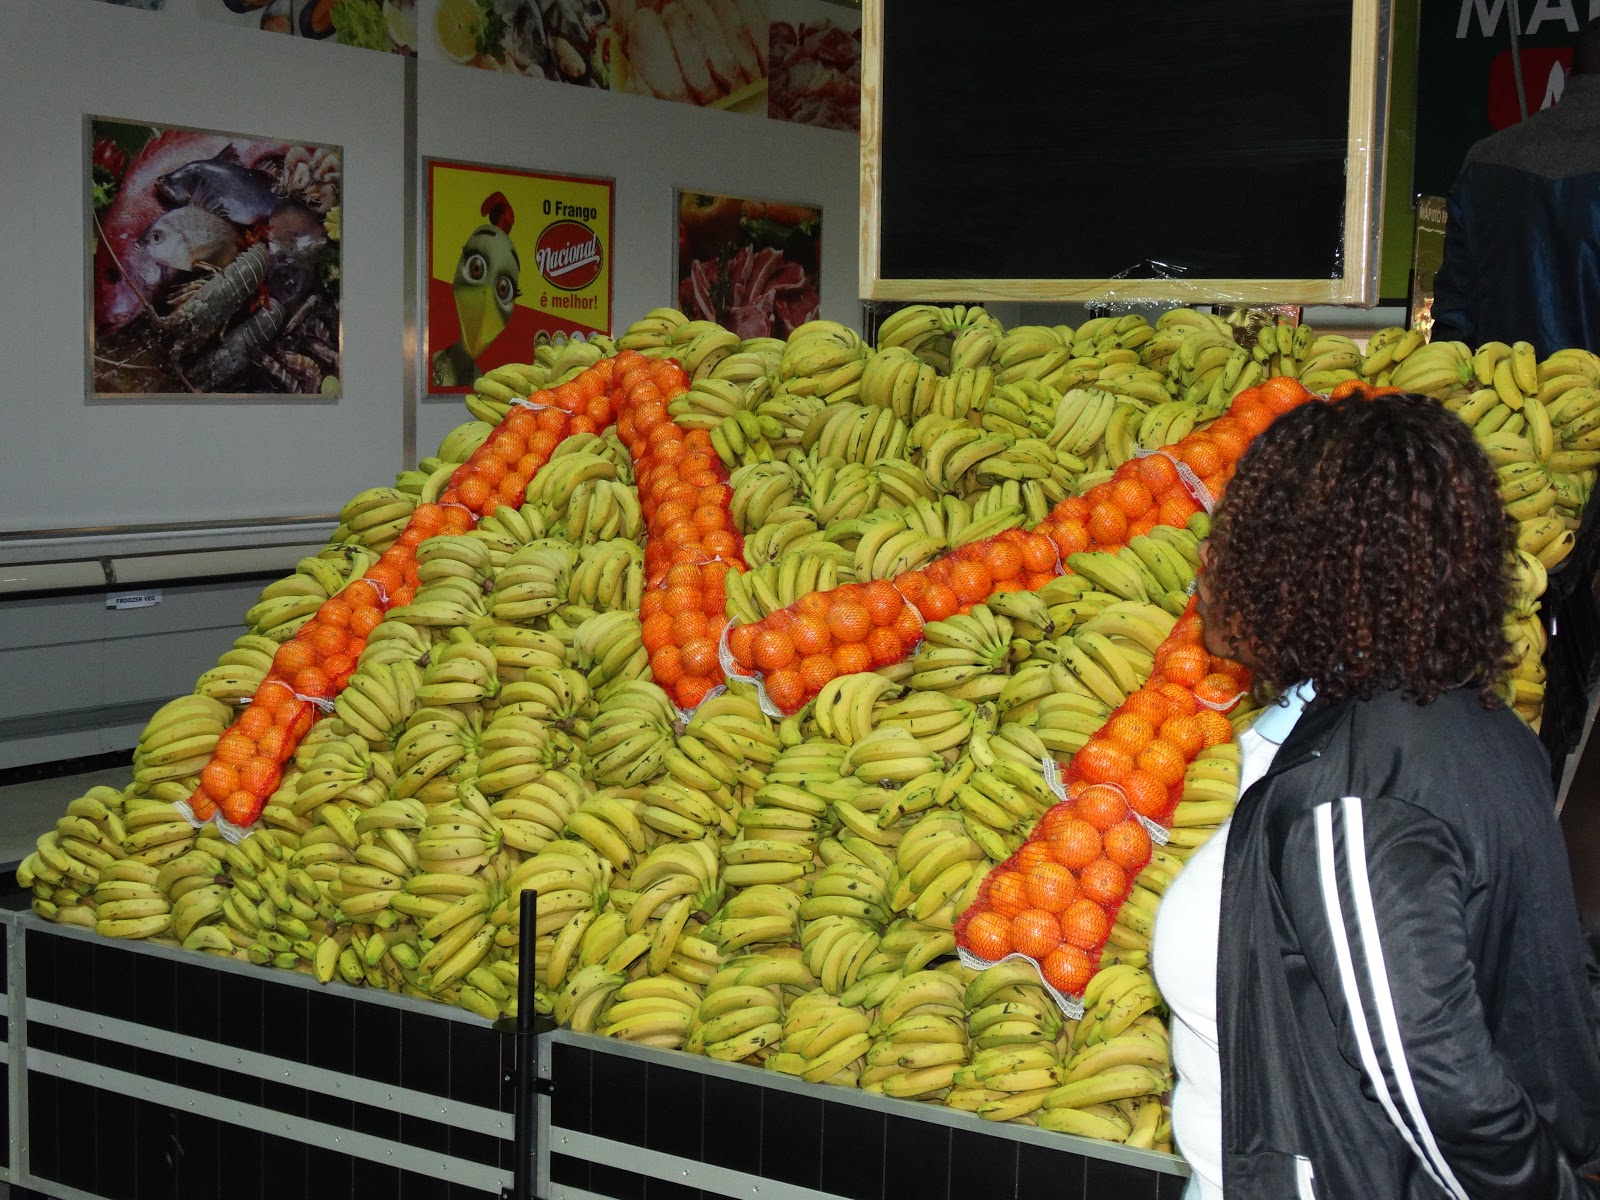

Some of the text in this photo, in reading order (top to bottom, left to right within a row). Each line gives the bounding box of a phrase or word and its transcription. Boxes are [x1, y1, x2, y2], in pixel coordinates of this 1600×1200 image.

[1455, 0, 1600, 39] MA
[543, 200, 597, 221] O Frango
[536, 234, 599, 276] Nacional
[540, 292, 598, 310] é melhor!
